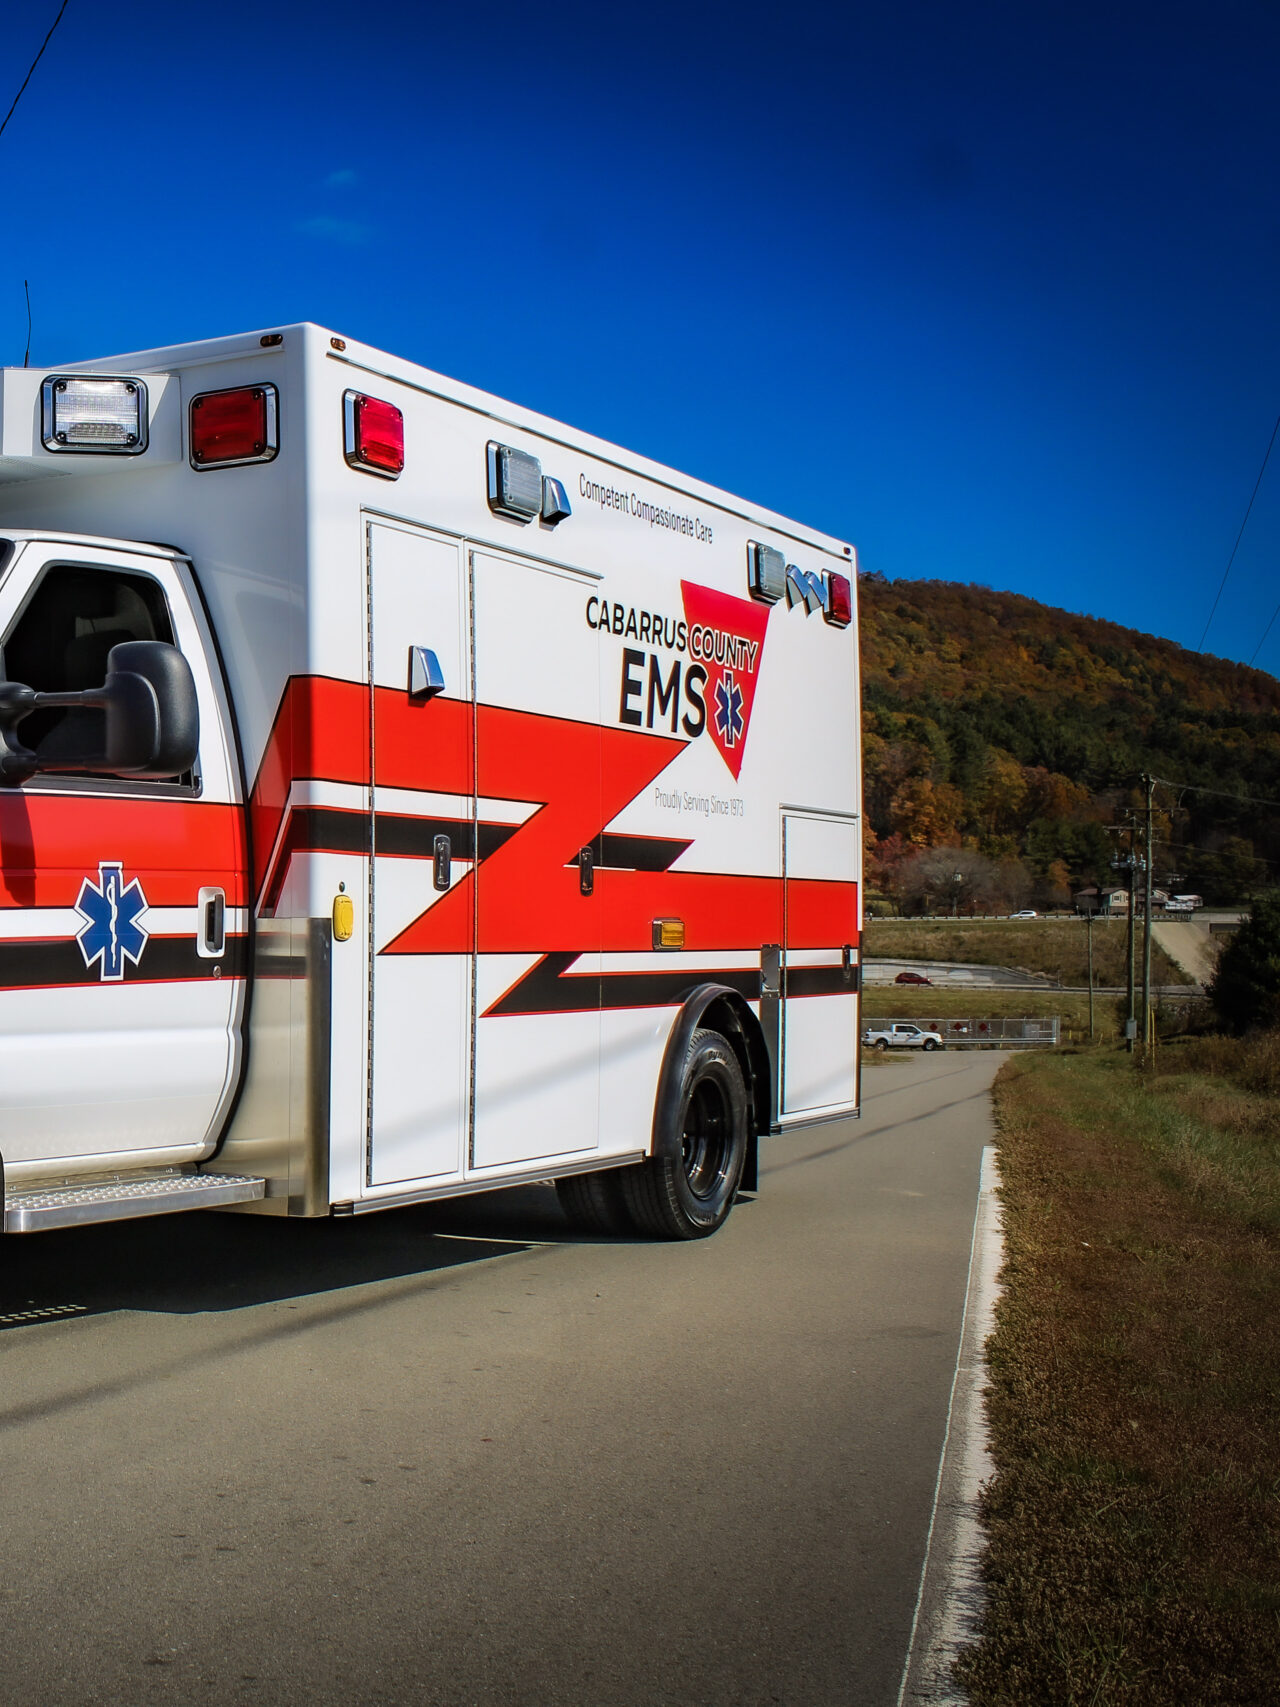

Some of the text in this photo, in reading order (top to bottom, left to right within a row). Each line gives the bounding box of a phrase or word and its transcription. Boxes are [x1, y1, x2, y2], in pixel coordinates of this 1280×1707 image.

[579, 473, 713, 544] Competent Compassionate Care
[586, 596, 759, 674] CABARRUS COUNTY
[619, 647, 708, 738] EMS
[655, 787, 744, 817] Proudly Serving Since 1973
